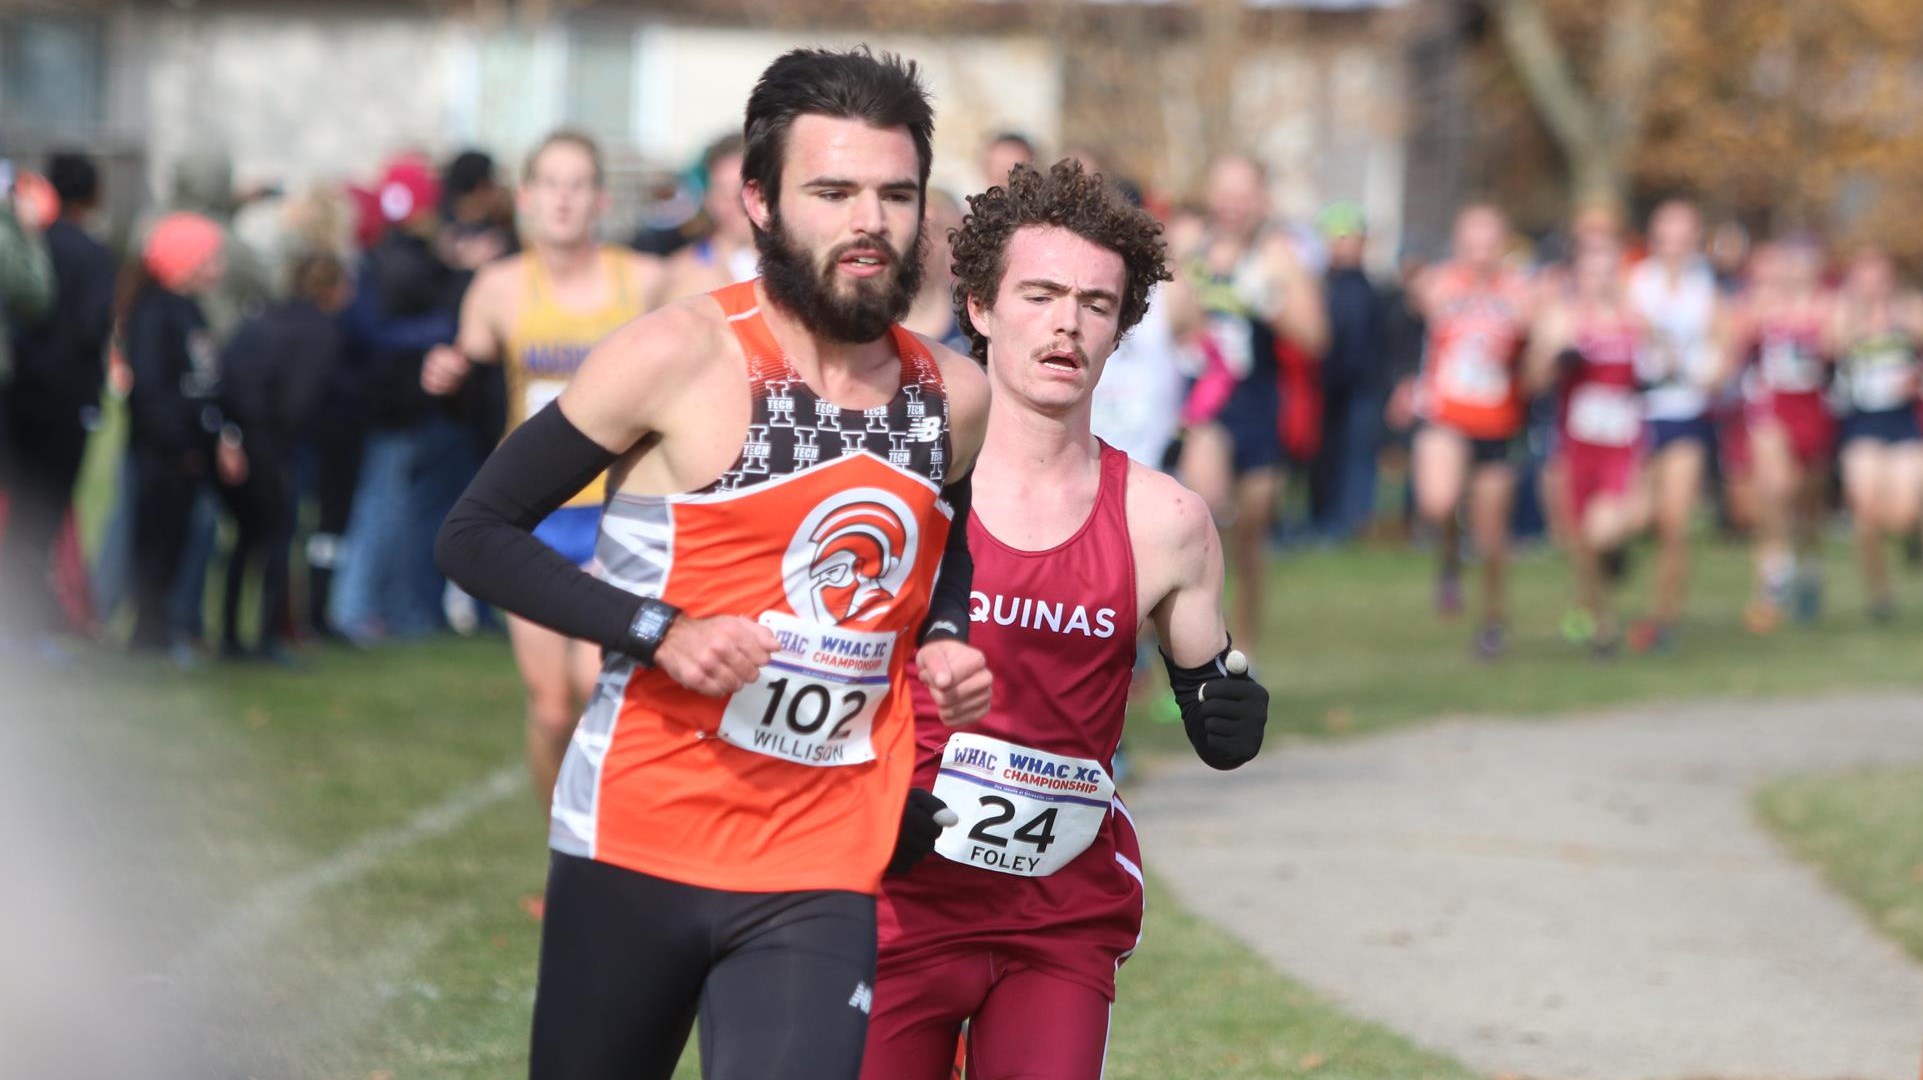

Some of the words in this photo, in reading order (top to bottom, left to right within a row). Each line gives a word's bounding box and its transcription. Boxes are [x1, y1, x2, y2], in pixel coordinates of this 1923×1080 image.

[766, 399, 795, 411] TECH
[815, 402, 840, 415] TECH
[907, 404, 925, 416] TECH
[743, 444, 770, 456] TECH
[793, 447, 819, 459] TECH
[888, 452, 911, 463] TECH
[968, 590, 1117, 639] QUINAS
[821, 635, 871, 659] WHAC
[872, 642, 888, 658] XC
[760, 677, 868, 741] 102
[753, 729, 844, 762] WILLISON
[954, 747, 998, 771] WHAC
[1009, 753, 1070, 778] WHAC
[1072, 766, 1101, 784] XC
[1003, 768, 1098, 794] CHAMPIONSHIP
[967, 794, 1059, 854] 24
[970, 845, 1040, 873] FOLEY
